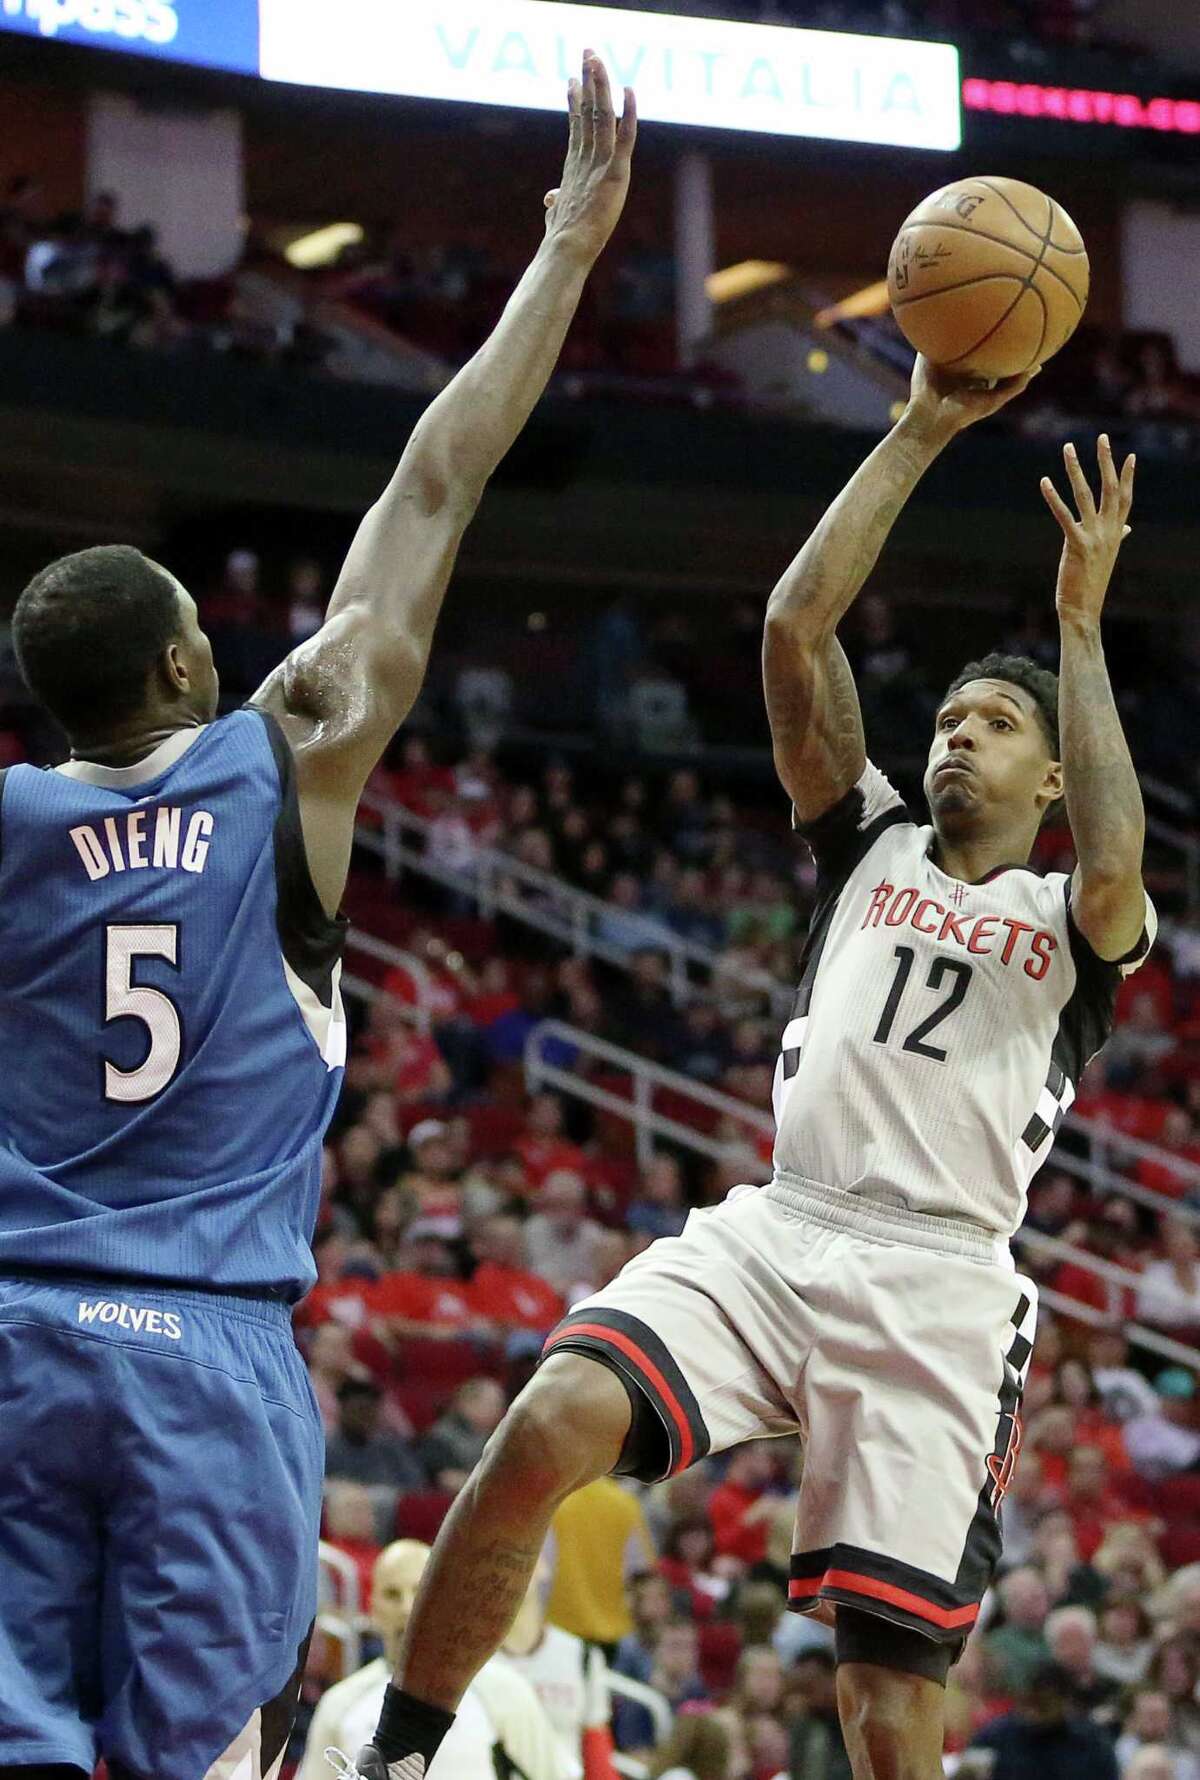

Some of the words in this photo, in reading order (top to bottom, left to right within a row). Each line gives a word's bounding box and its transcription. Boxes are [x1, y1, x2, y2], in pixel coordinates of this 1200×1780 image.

[2, 0, 178, 43] pass
[434, 22, 926, 115] VALVITALIA
[69, 807, 214, 881] DIENG
[861, 879, 1058, 982] ROCKETS
[104, 924, 182, 1102] 5
[873, 944, 973, 1063] 12
[78, 1300, 182, 1340] WOLVES
